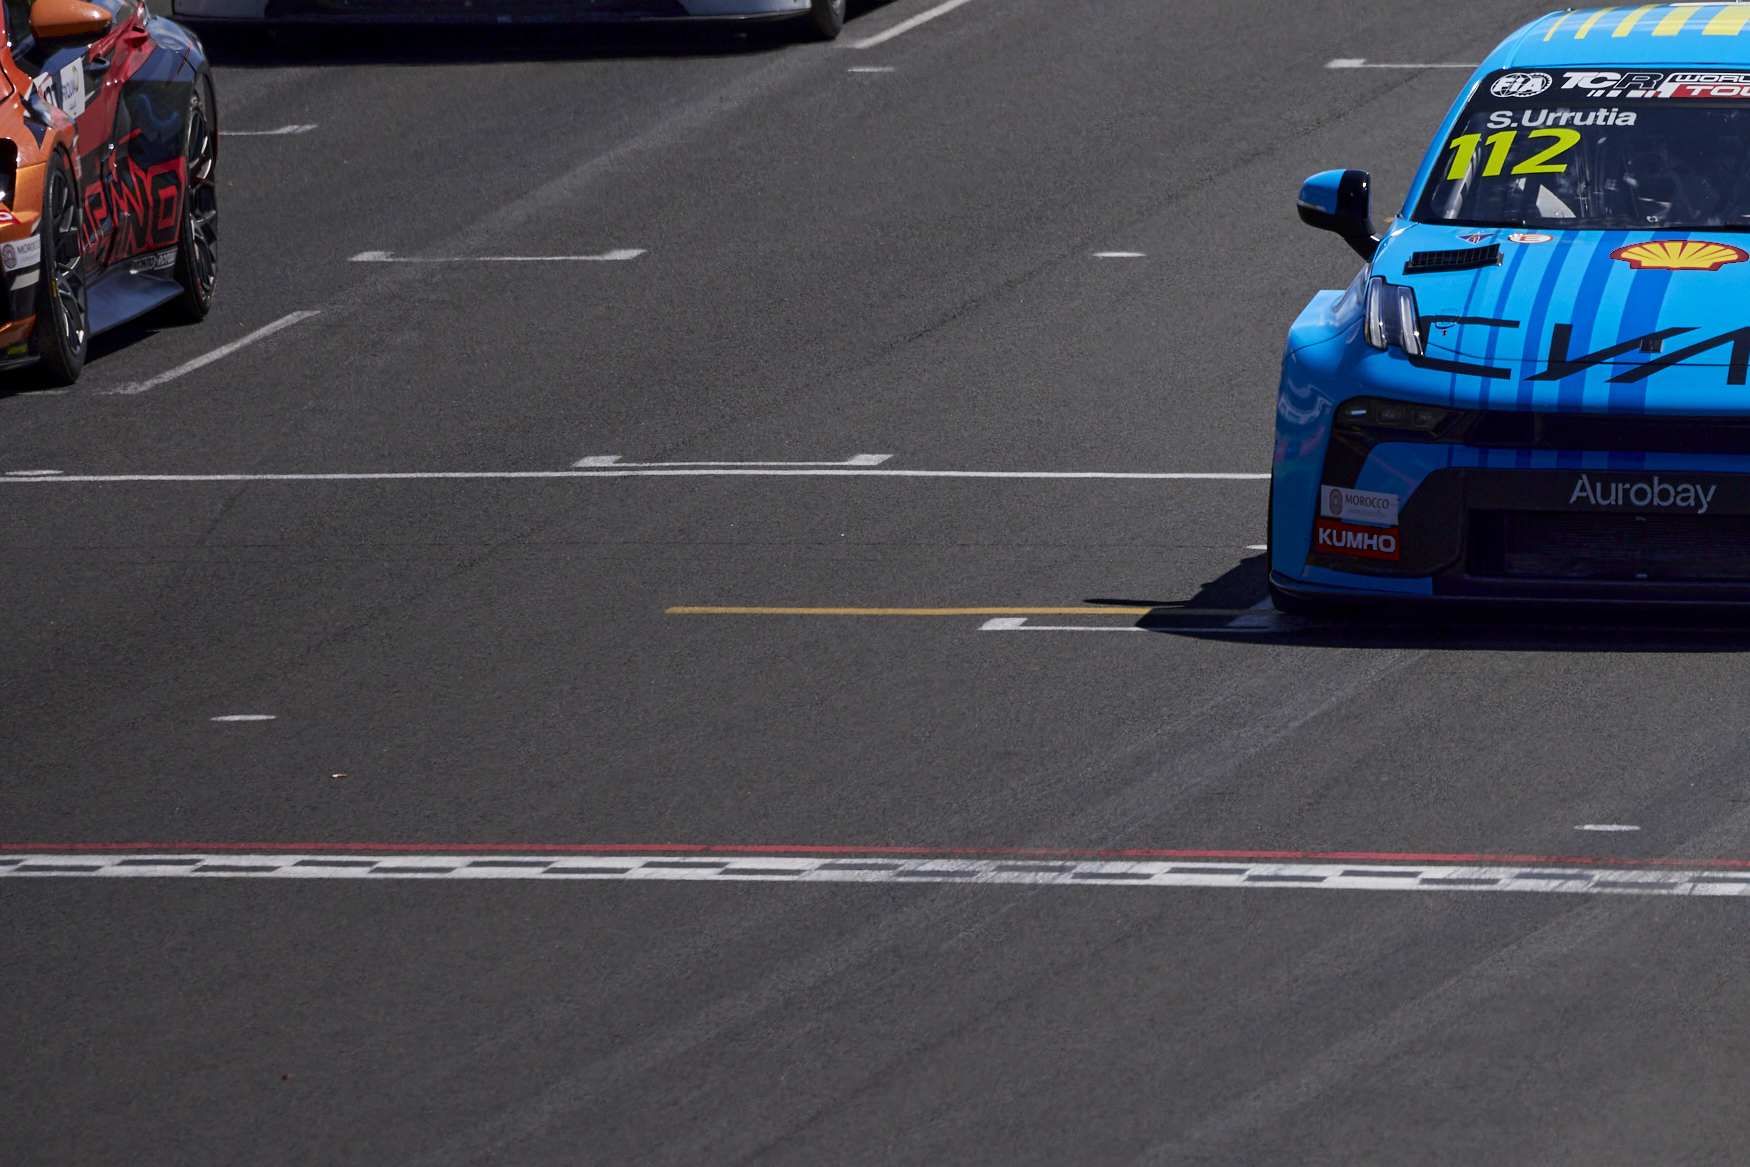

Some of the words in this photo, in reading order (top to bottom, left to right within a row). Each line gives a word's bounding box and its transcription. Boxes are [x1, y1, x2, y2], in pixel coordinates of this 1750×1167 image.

[1491, 76, 1544, 94] FIA
[1561, 71, 1665, 90] TCR
[1486, 107, 1638, 129] S.Urrutia
[1445, 128, 1582, 182] 112
[1345, 493, 1390, 510] MOROCCO
[1569, 473, 1717, 515] Aurobay
[1318, 527, 1397, 553] KUMHO
